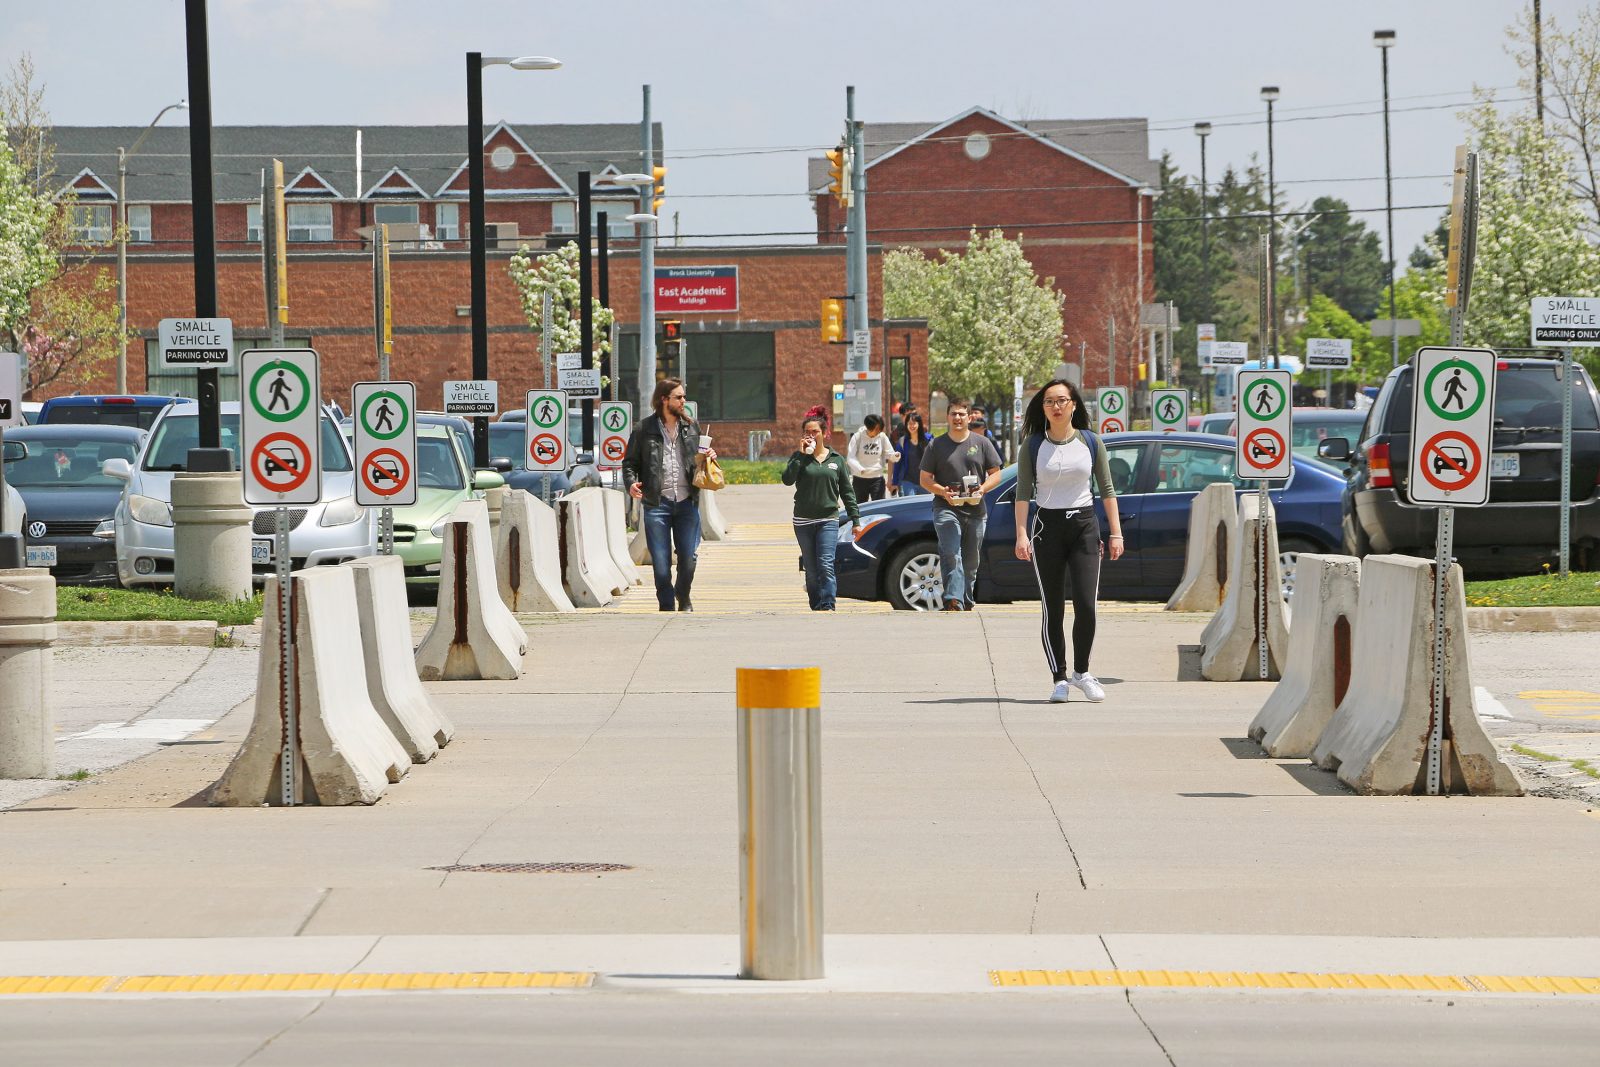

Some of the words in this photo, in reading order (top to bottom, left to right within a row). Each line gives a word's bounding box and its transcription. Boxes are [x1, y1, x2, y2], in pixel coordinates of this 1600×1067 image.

[659, 287, 680, 296] East
[680, 286, 726, 296] Academic
[1548, 300, 1591, 311] SMALL
[1542, 314, 1596, 324] VEHICLE
[176, 321, 215, 332] SMALL
[1537, 330, 1576, 338] PARKING
[170, 335, 221, 345] VEHICLE
